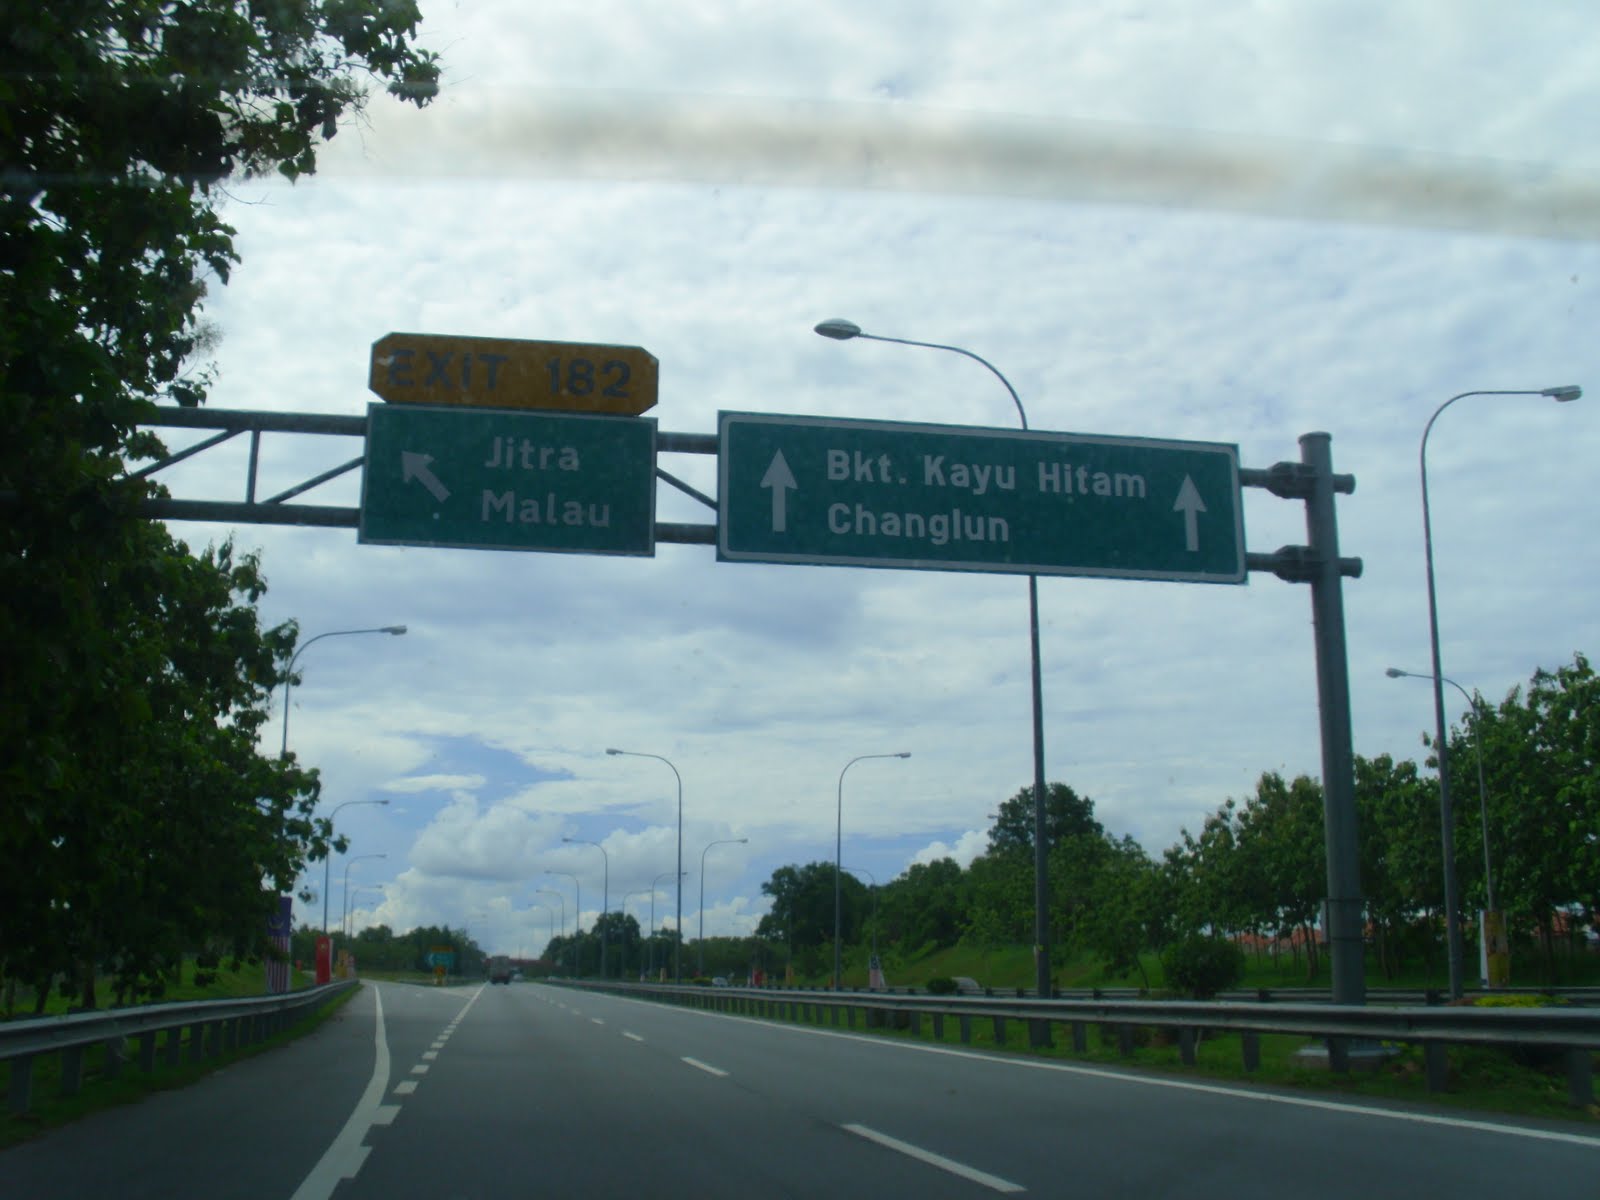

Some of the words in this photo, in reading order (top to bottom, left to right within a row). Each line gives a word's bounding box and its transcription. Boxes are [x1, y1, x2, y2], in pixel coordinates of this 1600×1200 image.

[545, 357, 632, 398] 182
[485, 437, 580, 471] Jitra
[827, 449, 907, 484] Bkt.
[923, 456, 1016, 496] Kayu
[1038, 462, 1147, 499] Hitam
[482, 489, 611, 527] Malau
[827, 502, 1010, 545] Changlun
